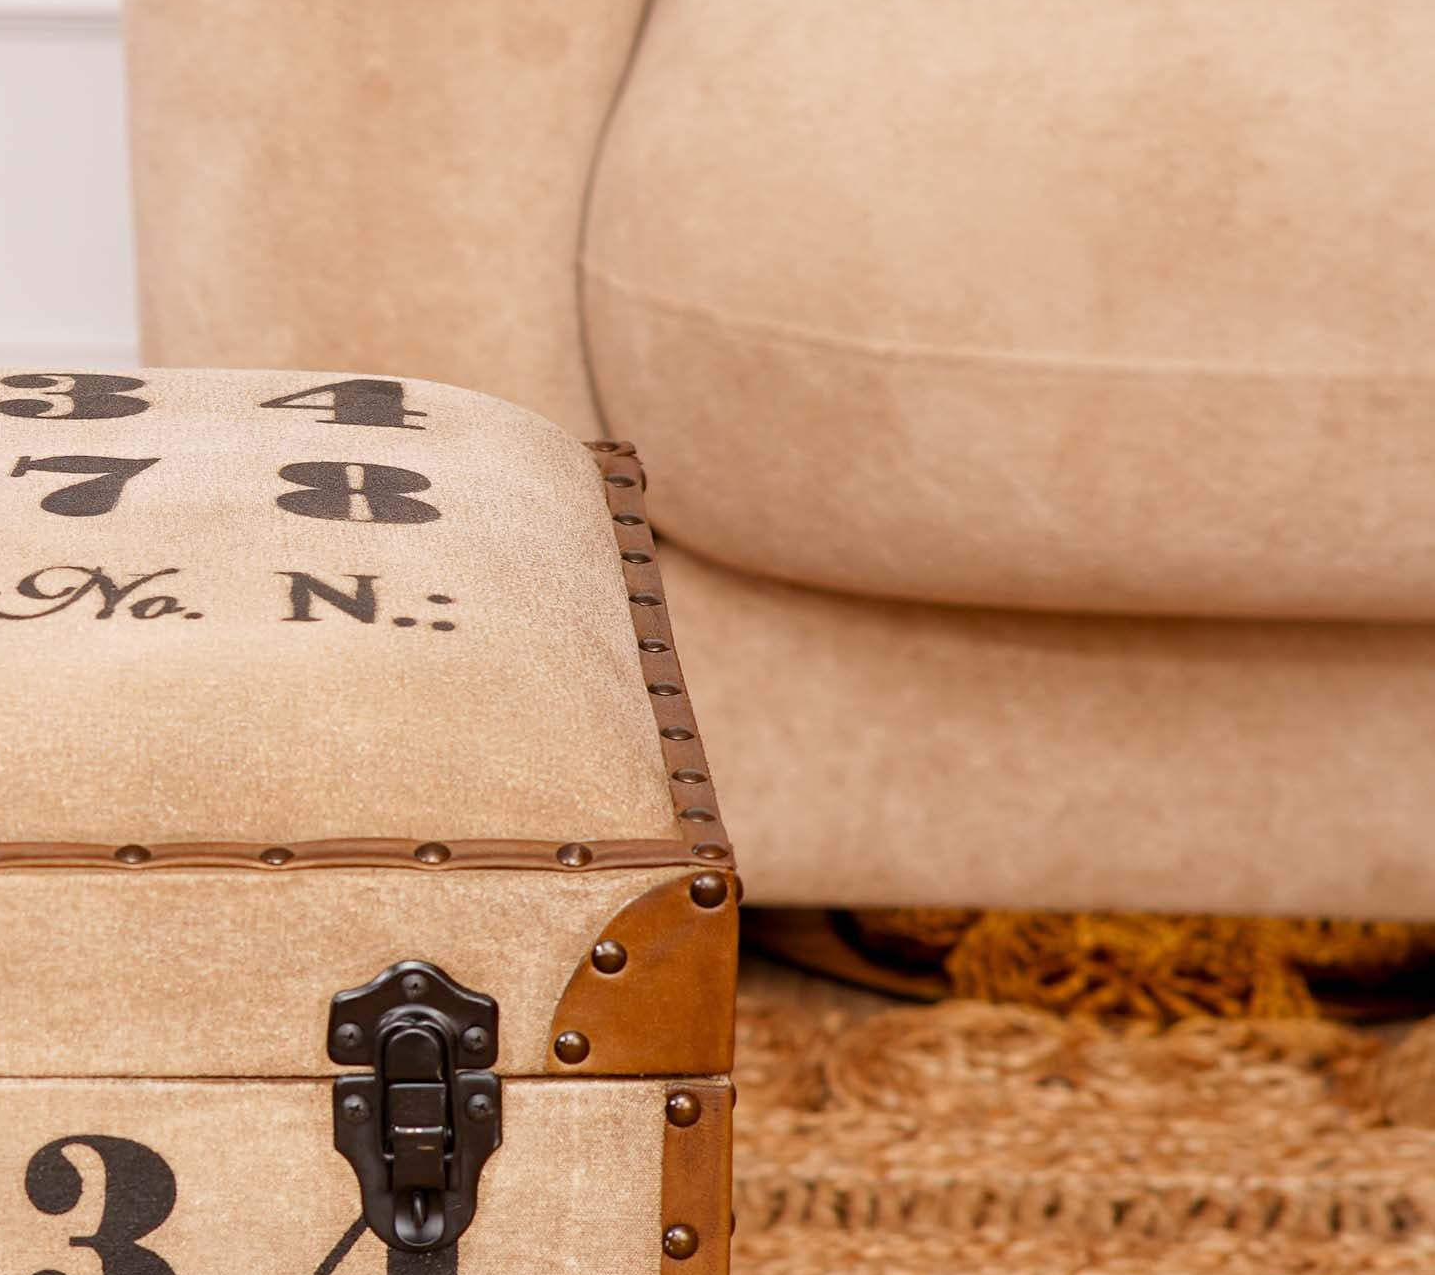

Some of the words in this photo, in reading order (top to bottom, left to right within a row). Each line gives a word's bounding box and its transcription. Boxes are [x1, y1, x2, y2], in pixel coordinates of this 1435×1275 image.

[258, 379, 428, 430] 4
[9, 455, 161, 517] 7
[276, 461, 441, 524] 8
